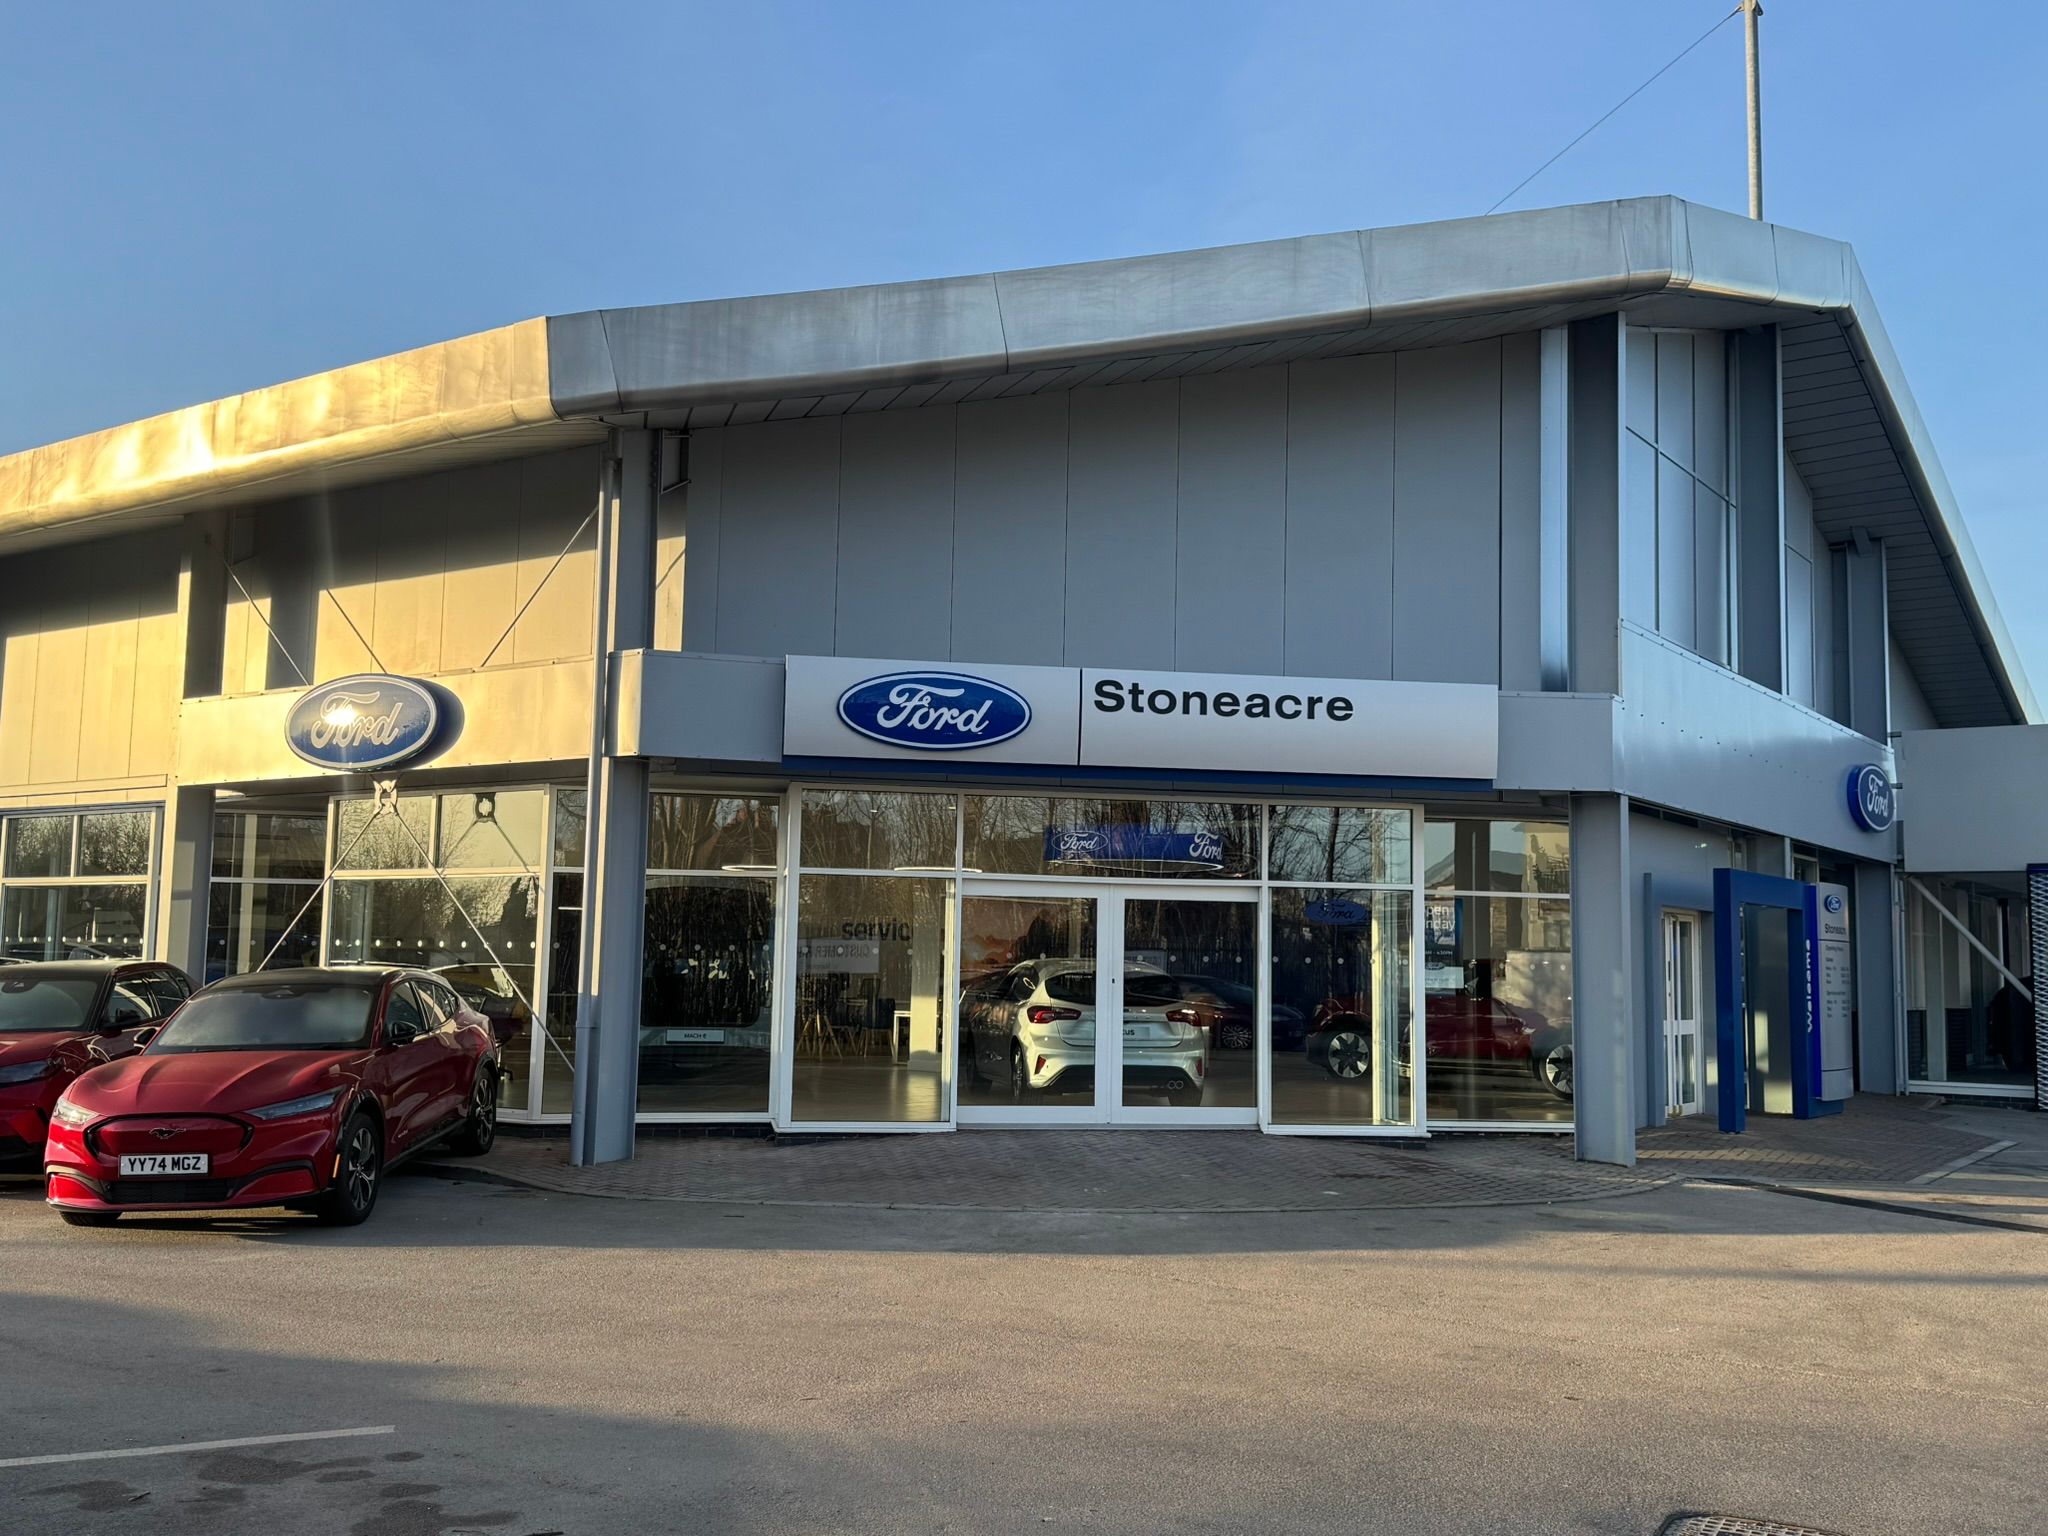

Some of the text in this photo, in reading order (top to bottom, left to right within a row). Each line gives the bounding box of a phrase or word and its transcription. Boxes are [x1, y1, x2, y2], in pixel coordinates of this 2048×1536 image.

[877, 683, 993, 735] Ford
[1094, 679, 1354, 722] Stoneacre
[310, 691, 403, 749] Ford
[1867, 774, 1889, 818] Ford
[1061, 833, 1098, 850] Ford
[1189, 829, 1224, 861] Ford
[1426, 905, 1449, 917] pen
[842, 918, 911, 941] servic
[1426, 918, 1456, 932] nday
[128, 1156, 201, 1171] YY74 MGZ
